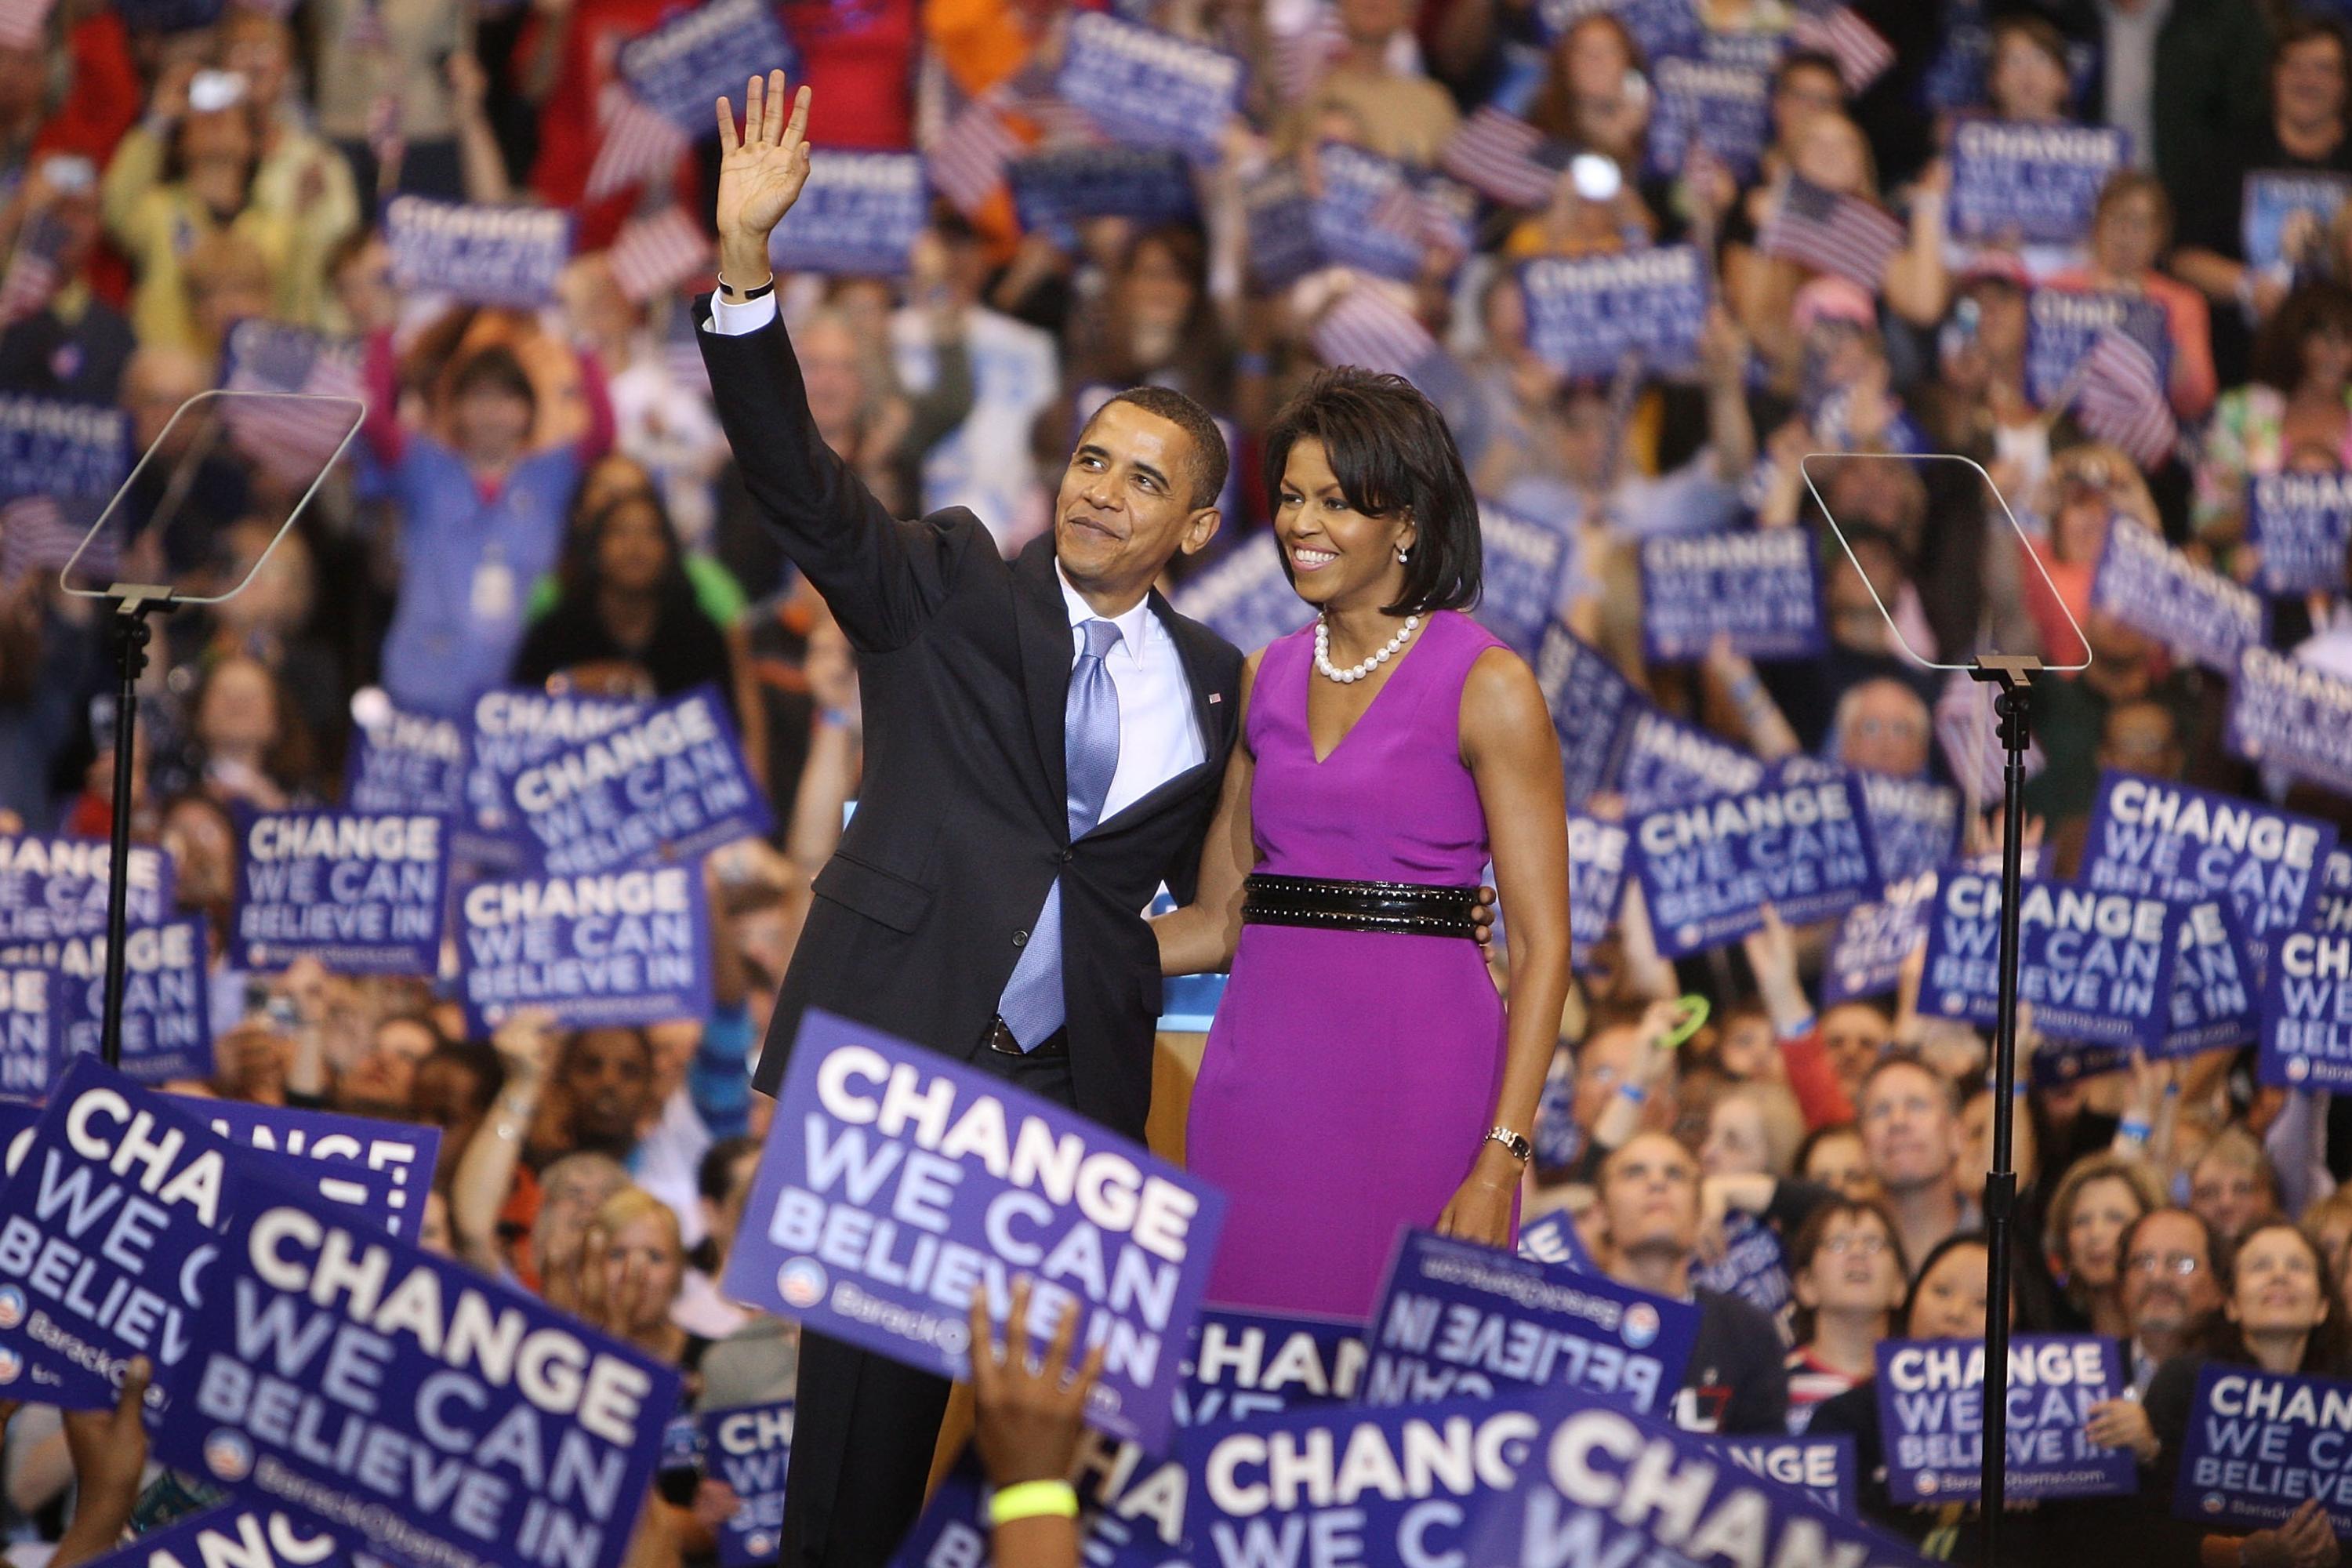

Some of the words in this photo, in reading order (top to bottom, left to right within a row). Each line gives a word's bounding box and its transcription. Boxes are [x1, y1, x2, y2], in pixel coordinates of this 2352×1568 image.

[514, 696, 719, 813] CHANGE
[249, 815, 441, 862] CHANGE
[1639, 782, 1852, 855] CHANGE
[2110, 779, 2320, 869] CHANGE
[246, 861, 315, 903] WE
[329, 859, 438, 904] CAN
[464, 867, 688, 927] CHANGE
[2196, 845, 2311, 911] CAN
[240, 902, 385, 940] BELIEVE
[572, 913, 692, 958] CAN
[468, 955, 640, 1003] BELIEVE
[2045, 928, 2161, 982] CAN
[2281, 932, 2352, 981] CH
[2108, 980, 2154, 1018] IN
[2275, 1016, 2352, 1058] BEL
[66, 1087, 226, 1229] CHA
[815, 1045, 1200, 1264] CHANGE
[35, 1146, 172, 1276] WE
[804, 1110, 965, 1234] WE
[984, 1189, 1181, 1332] CAN
[0, 1214, 192, 1367] BELIEV
[249, 1207, 652, 1448] CHANGE
[1088, 1308, 1162, 1388] IN
[234, 1276, 397, 1411] WE
[414, 1370, 625, 1523] CAN
[1893, 1389, 1984, 1434] WE
[2209, 1374, 2352, 1432] CHAN
[195, 1353, 510, 1541] BELIEVE
[517, 1491, 604, 1568] IN
[718, 1407, 795, 1456] CH
[1204, 1410, 1541, 1516] CHANG
[2205, 1414, 2293, 1464] WE
